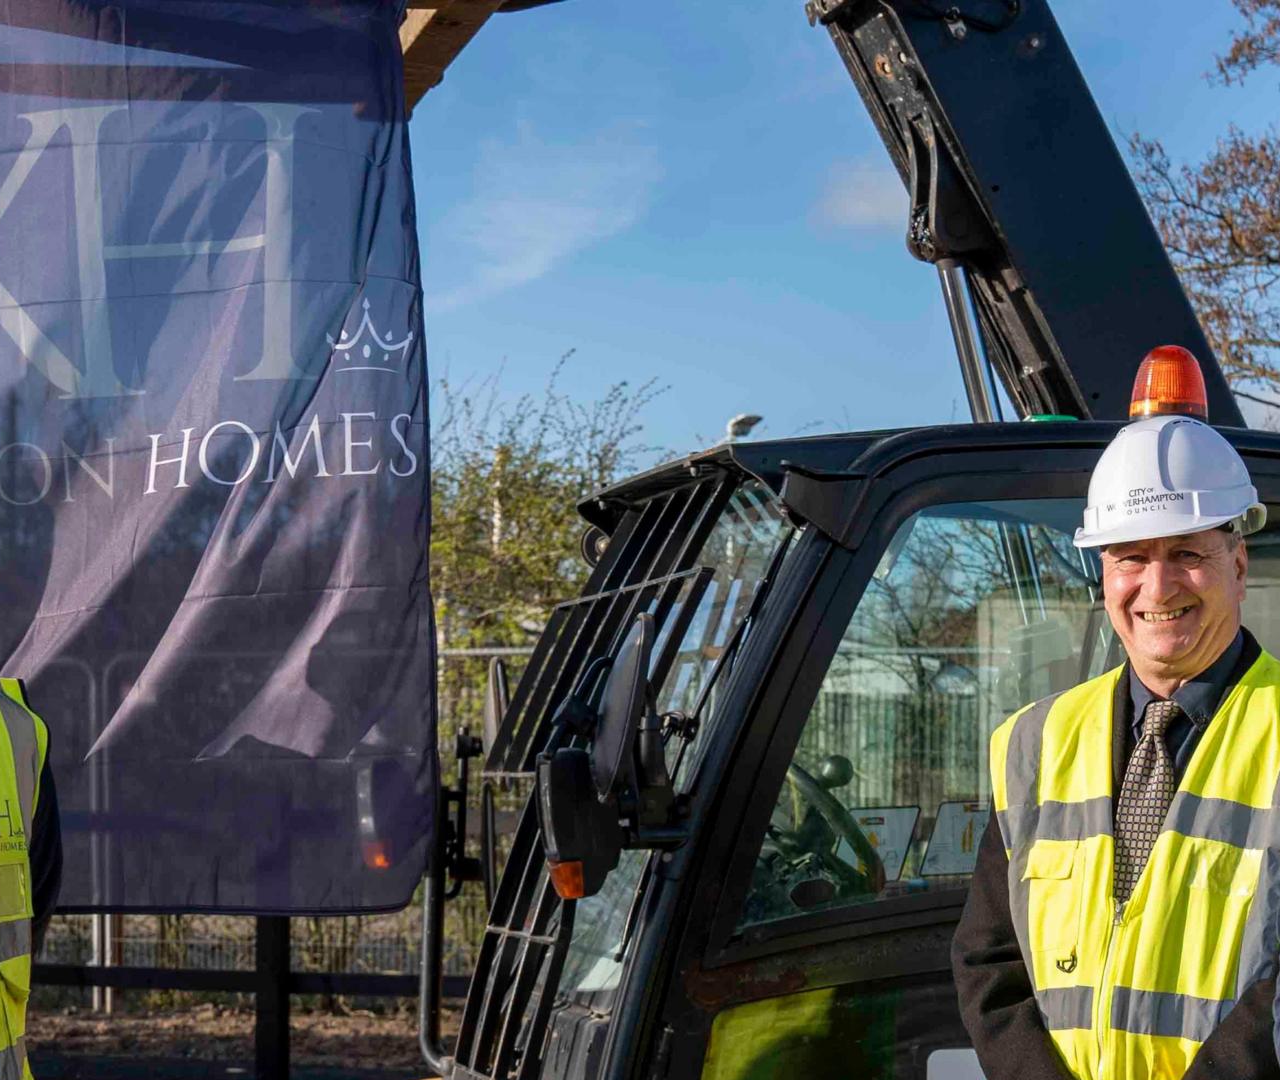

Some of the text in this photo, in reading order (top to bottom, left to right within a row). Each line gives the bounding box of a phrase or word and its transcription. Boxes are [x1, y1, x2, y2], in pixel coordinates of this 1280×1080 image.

[143, 411, 418, 495] HOMES
[1129, 488, 1146, 498] CITY
[1127, 504, 1167, 515] OUNCIL
